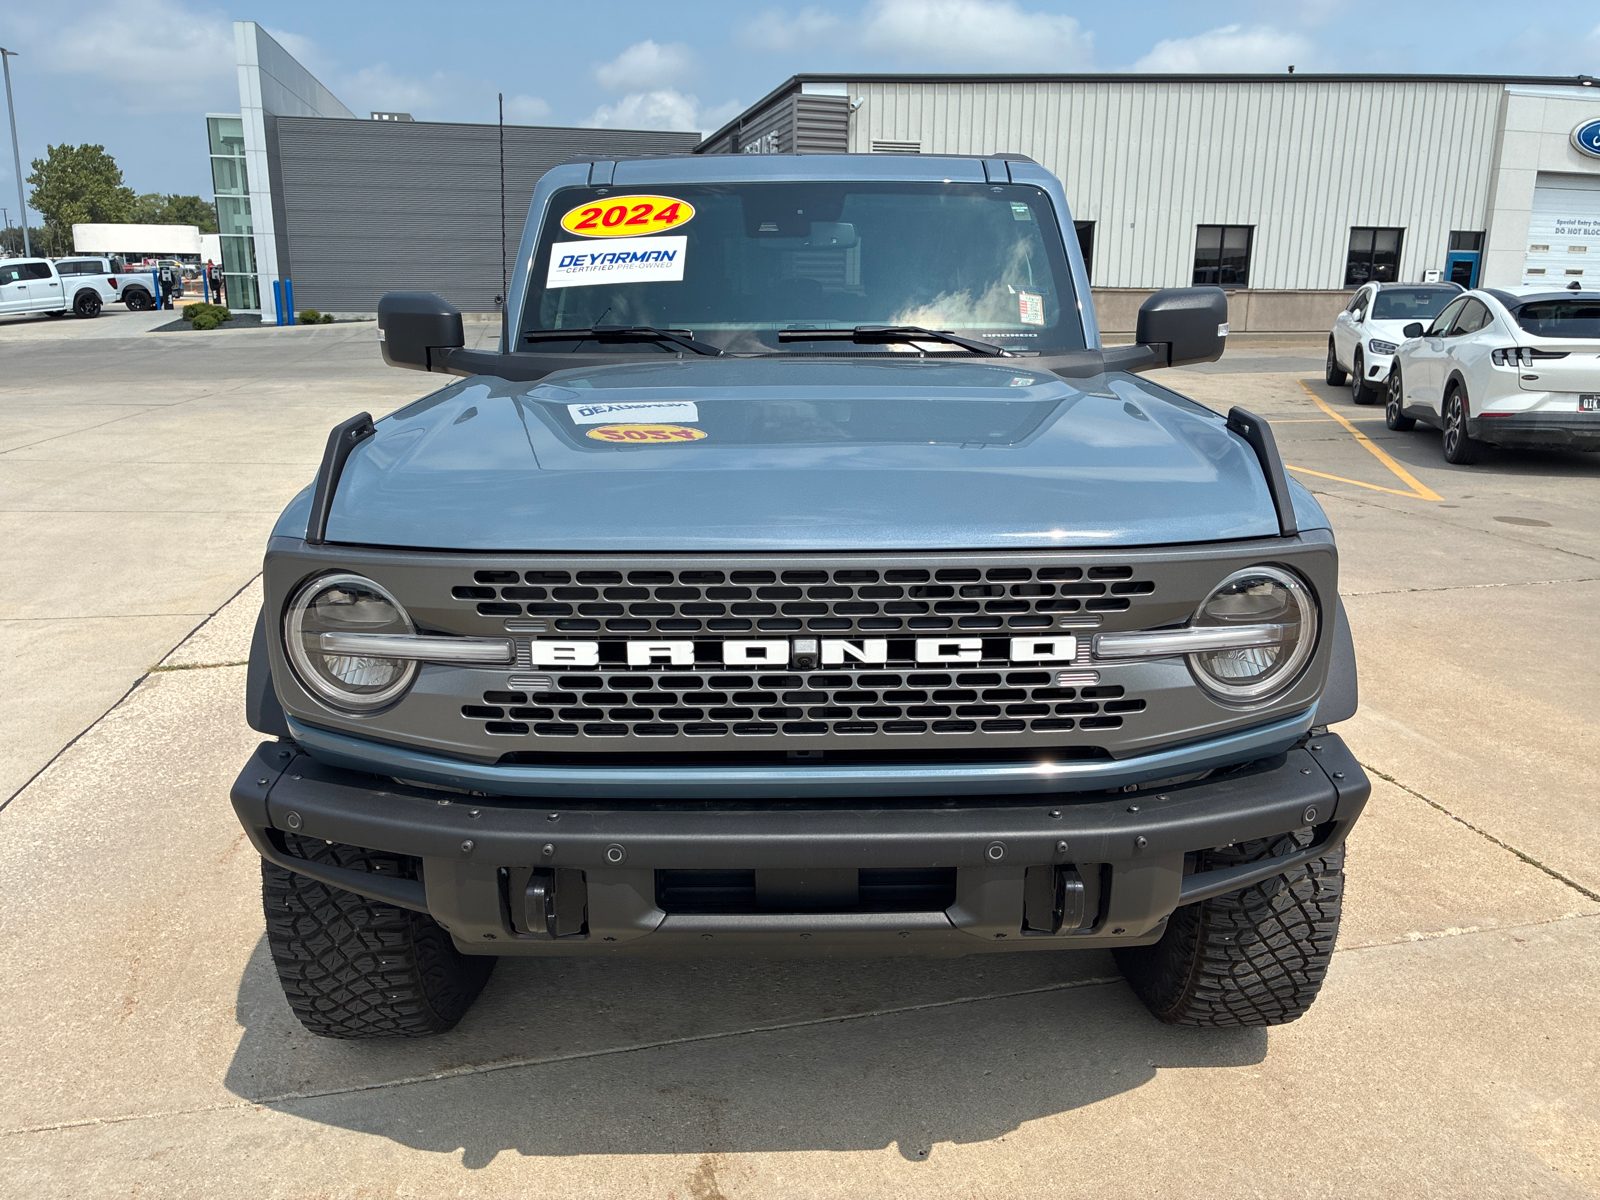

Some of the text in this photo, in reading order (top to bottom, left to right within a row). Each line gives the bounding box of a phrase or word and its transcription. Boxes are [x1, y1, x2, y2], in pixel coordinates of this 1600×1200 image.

[574, 203, 680, 229] 2024
[558, 250, 677, 267] DEYARMAN
[566, 262, 672, 273] CERTIFIED PRE-OWNED
[530, 636, 1076, 666] BRONCO
